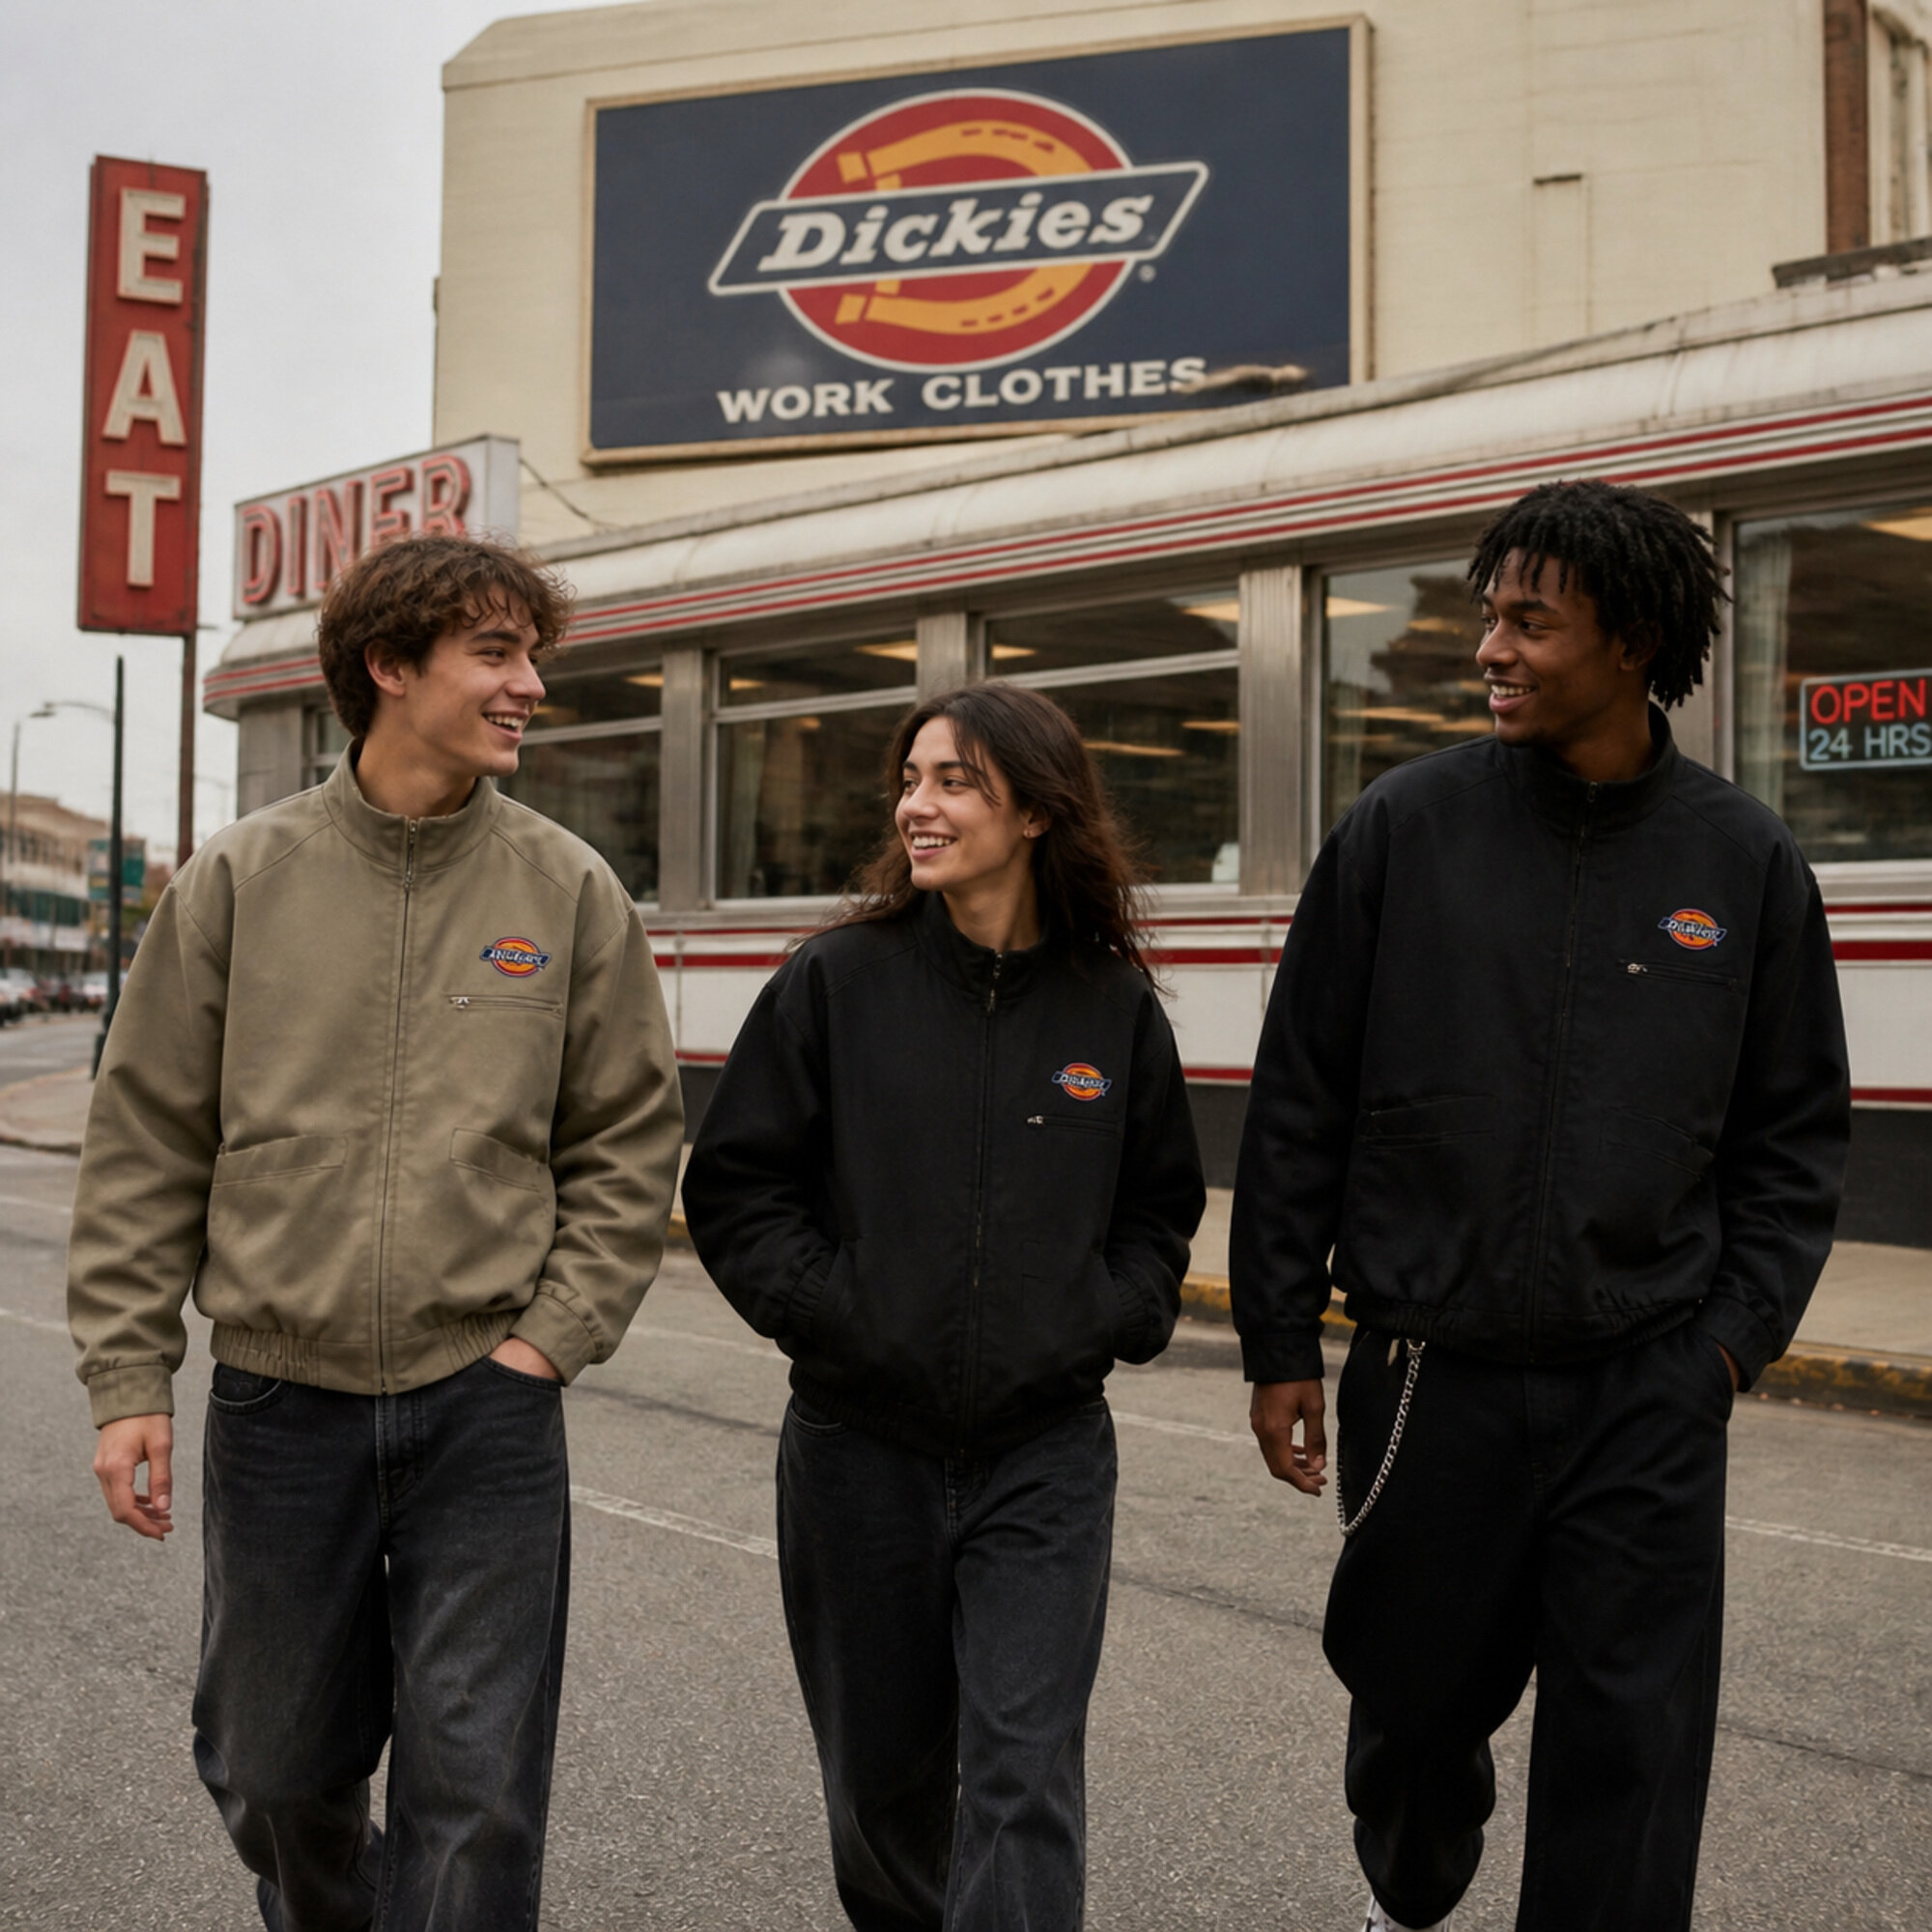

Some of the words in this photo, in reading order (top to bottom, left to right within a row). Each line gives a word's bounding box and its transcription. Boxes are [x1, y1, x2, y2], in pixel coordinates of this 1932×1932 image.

[757, 192, 1154, 272] Dickies
[101, 186, 187, 587] EAT
[717, 379, 895, 424] WORK
[922, 357, 1208, 411] CLOTHES
[242, 454, 471, 605] DINER
[1810, 678, 1927, 724] OPEN
[1808, 727, 1853, 761] 24
[1864, 722, 1932, 759] HRS
